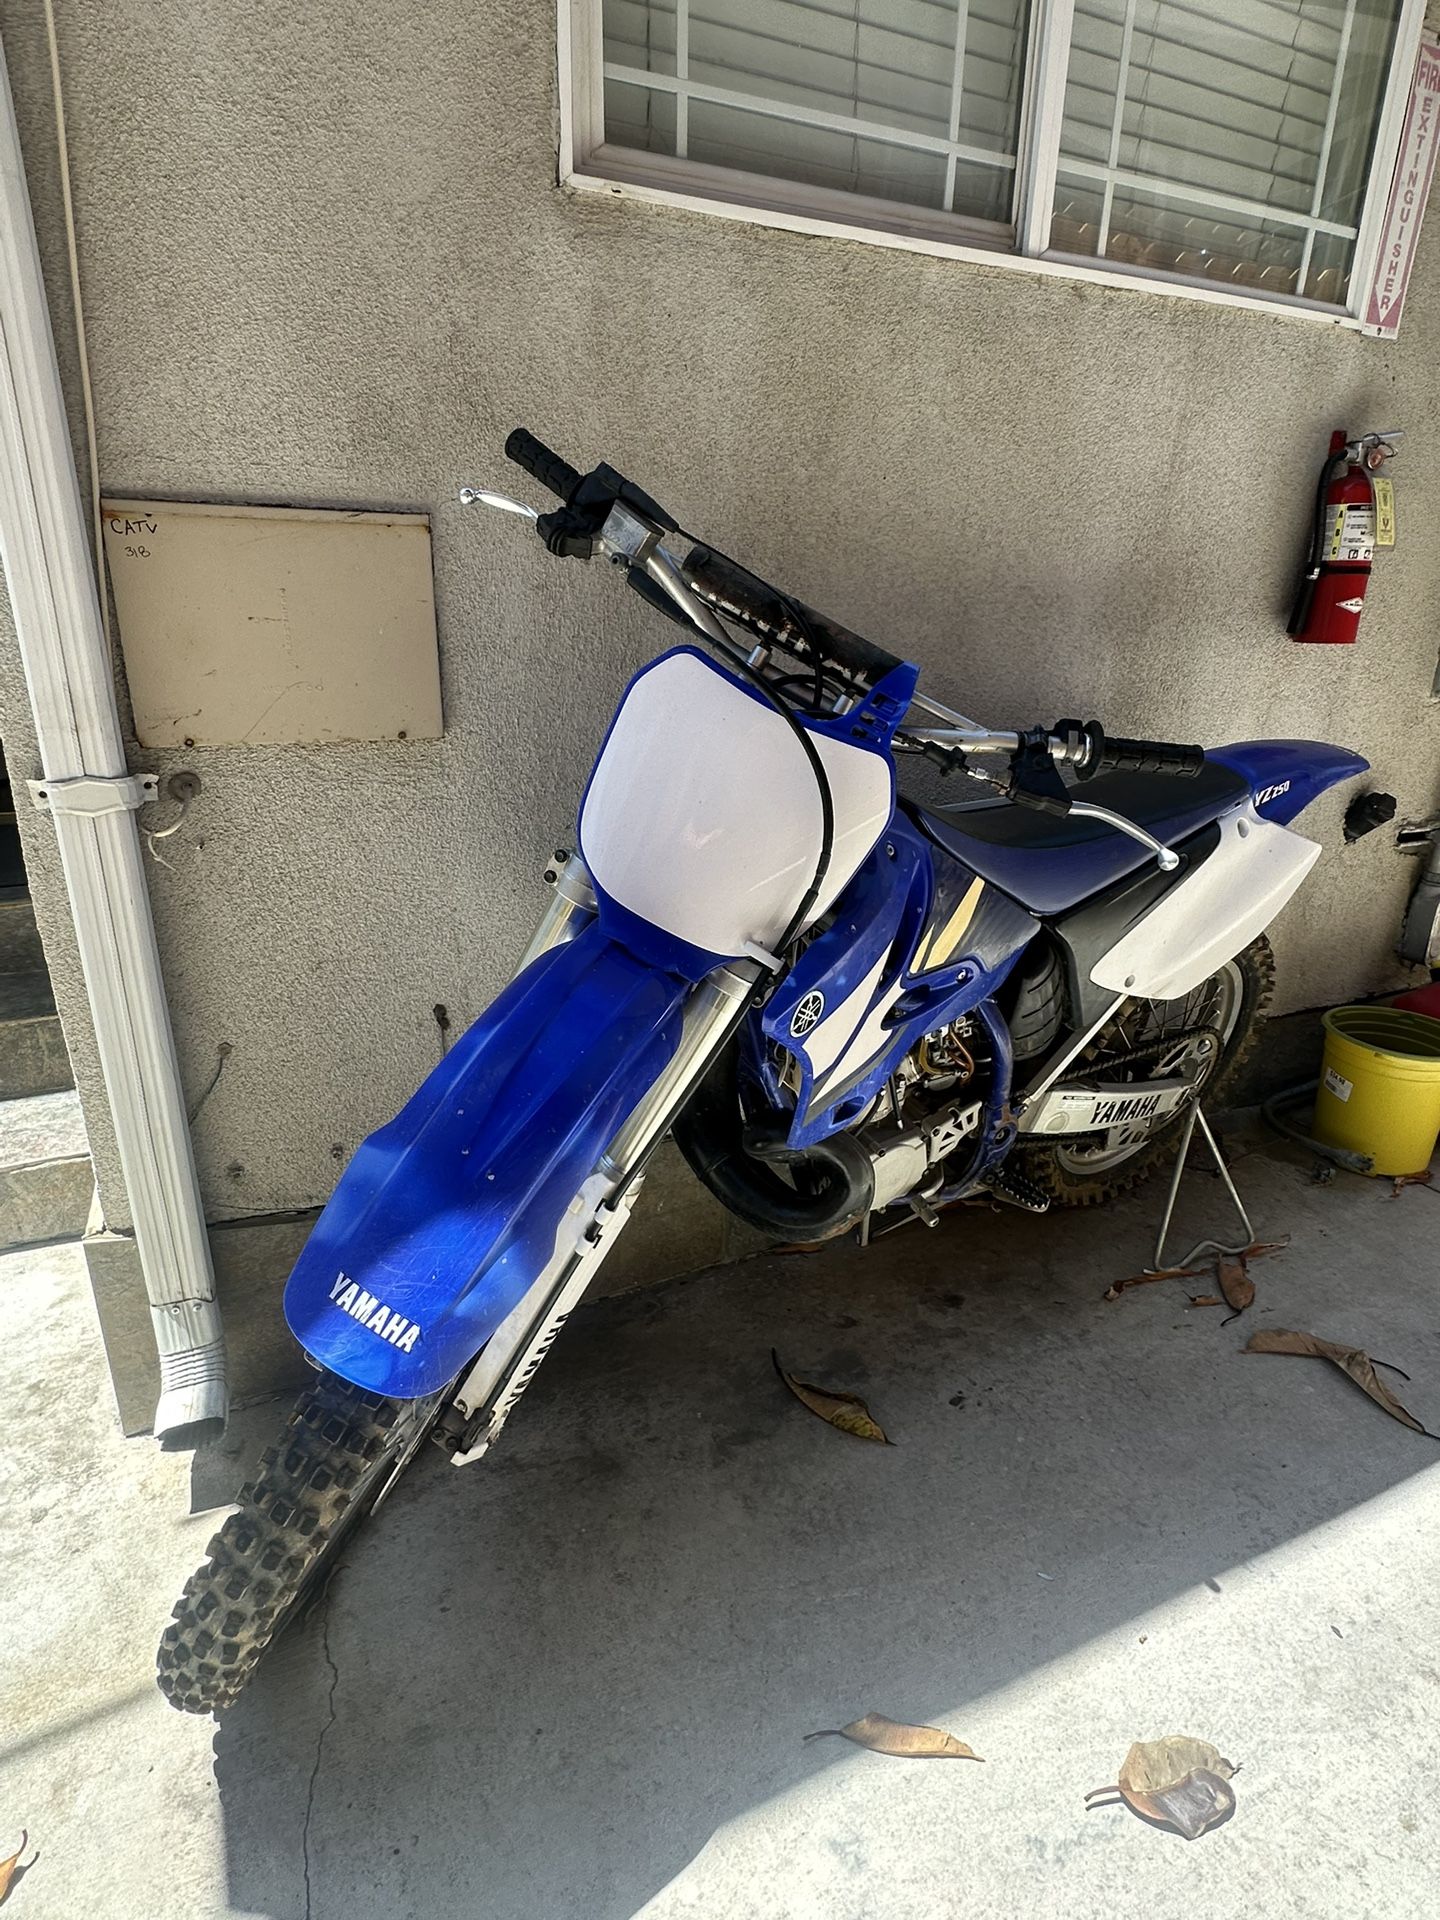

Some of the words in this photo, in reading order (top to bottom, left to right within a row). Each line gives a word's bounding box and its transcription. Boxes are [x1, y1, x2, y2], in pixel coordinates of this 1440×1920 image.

[1380, 96, 1433, 310] EXTINGUISHER
[110, 518, 158, 536] CATV
[124, 545, 151, 558] 318
[1090, 1094, 1162, 1124] YAMAHA
[329, 1271, 421, 1354] YAMAHA
